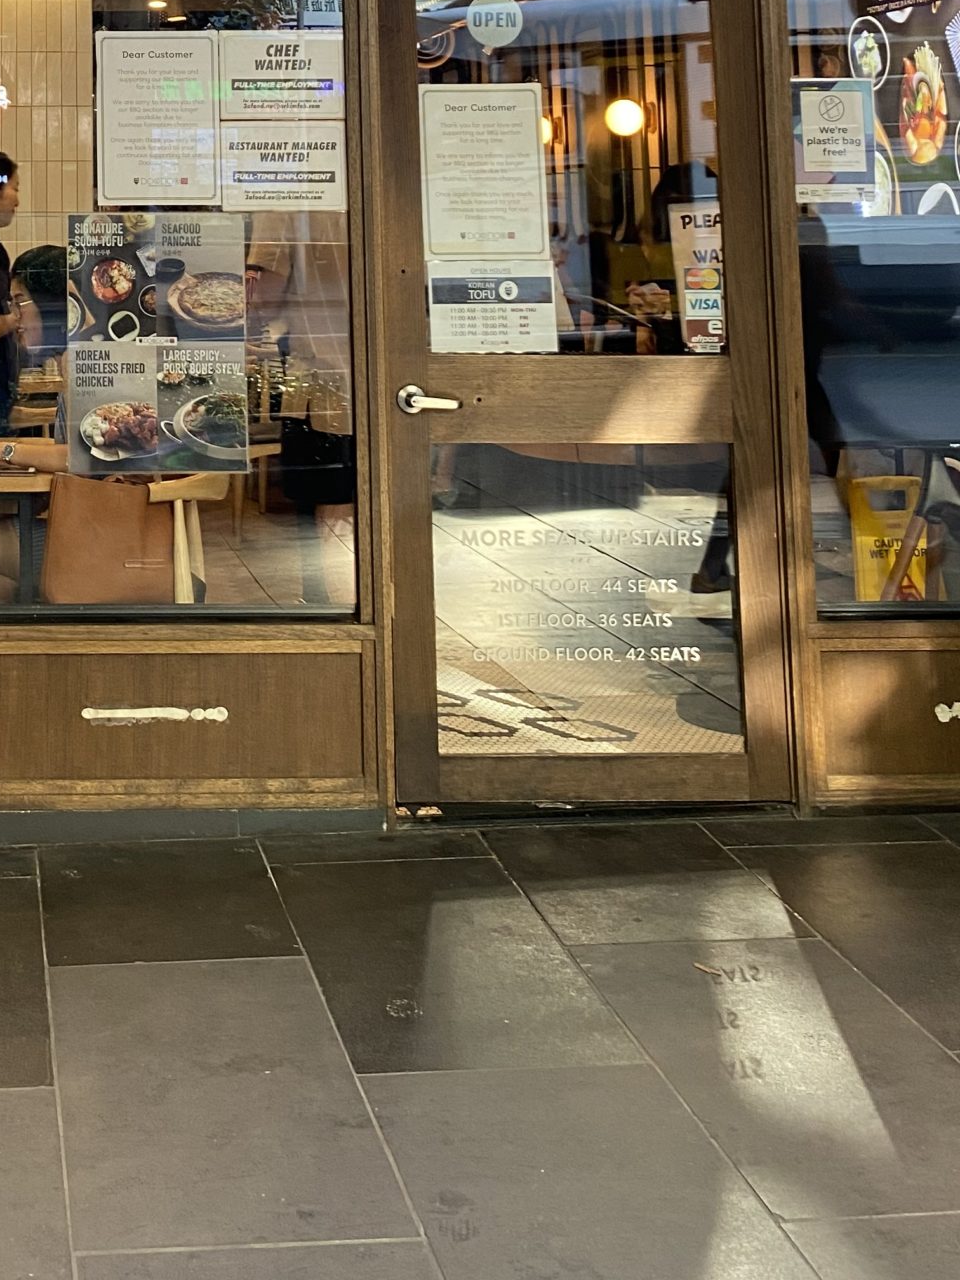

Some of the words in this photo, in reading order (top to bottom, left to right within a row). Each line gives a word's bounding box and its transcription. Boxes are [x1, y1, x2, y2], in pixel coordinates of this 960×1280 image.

[472, 11, 517, 28] OPEN
[122, 50, 145, 59] Dear
[147, 50, 193, 59] Customer
[266, 44, 300, 57] CHEF
[255, 58, 312, 71] WANTED!
[233, 81, 276, 89] FULL-TIME
[276, 81, 332, 89] EMPLOYMENT
[444, 103, 468, 112] Dear
[470, 103, 518, 112] Customer
[819, 126, 848, 134] We're
[228, 141, 289, 151] RESTAURANT
[291, 141, 338, 151] MANAGER
[806, 136, 840, 146] plastic
[843, 136, 861, 147] bag
[259, 152, 310, 163] WANTED!
[823, 148, 847, 156] free!
[74, 222, 124, 235] SIGNATURE
[161, 223, 201, 235] SEAFOOD
[74, 235, 101, 247] SOON
[101, 235, 124, 247] TOFU
[161, 235, 202, 247] PANCAKE
[468, 290, 496, 300] TOFU
[689, 299, 720, 310] VISA
[75, 350, 110, 361] KOREAN
[163, 349, 192, 361] LARGE
[193, 349, 220, 361] SPICY
[75, 362, 118, 374] BONELESS
[120, 362, 145, 374] FRIED
[163, 363, 188, 374] PORK
[189, 363, 215, 375] BONE
[217, 363, 241, 375] STEW
[75, 376, 114, 388] CHICKEN
[461, 529, 525, 547] MORE
[531, 529, 596, 547] SEATS
[600, 529, 704, 547] UPSTAIRS
[869, 548, 889, 559] WET
[490, 579, 527, 594] 2ND
[601, 579, 622, 593] 44
[627, 579, 679, 594] SEATS
[498, 613, 523, 628] 1ST
[598, 613, 618, 627] 36
[622, 613, 674, 628] SEATS
[472, 647, 551, 662] GROUND
[625, 647, 646, 661] 42
[649, 646, 702, 662] SEATS
